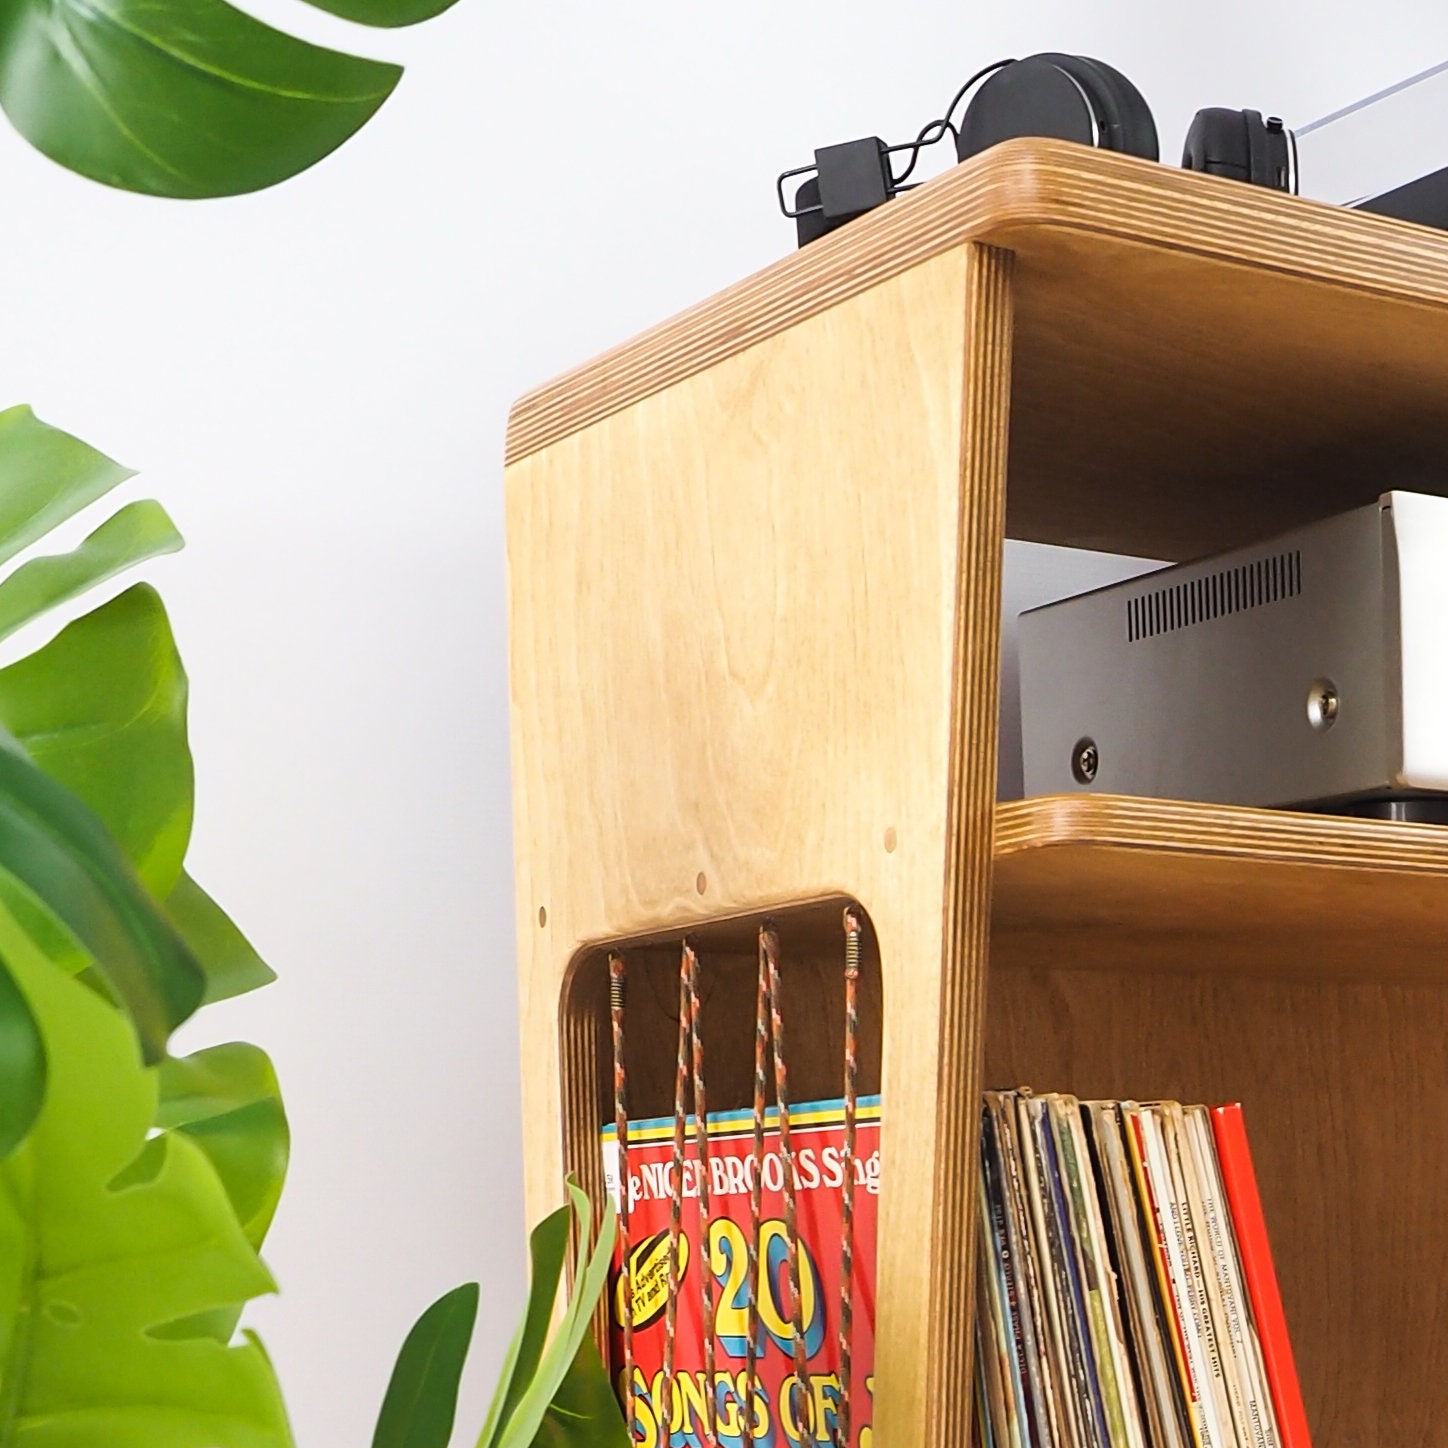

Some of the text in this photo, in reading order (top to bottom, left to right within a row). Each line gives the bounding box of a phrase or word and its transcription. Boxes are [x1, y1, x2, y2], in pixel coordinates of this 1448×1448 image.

[822, 1146, 881, 1195] Sng
[709, 1217, 825, 1360] 20
[1181, 1202, 1221, 1378] LITTLE RICHARD HIS GREATEST HITS
[1221, 1264, 1237, 1316] MANTOVANI
